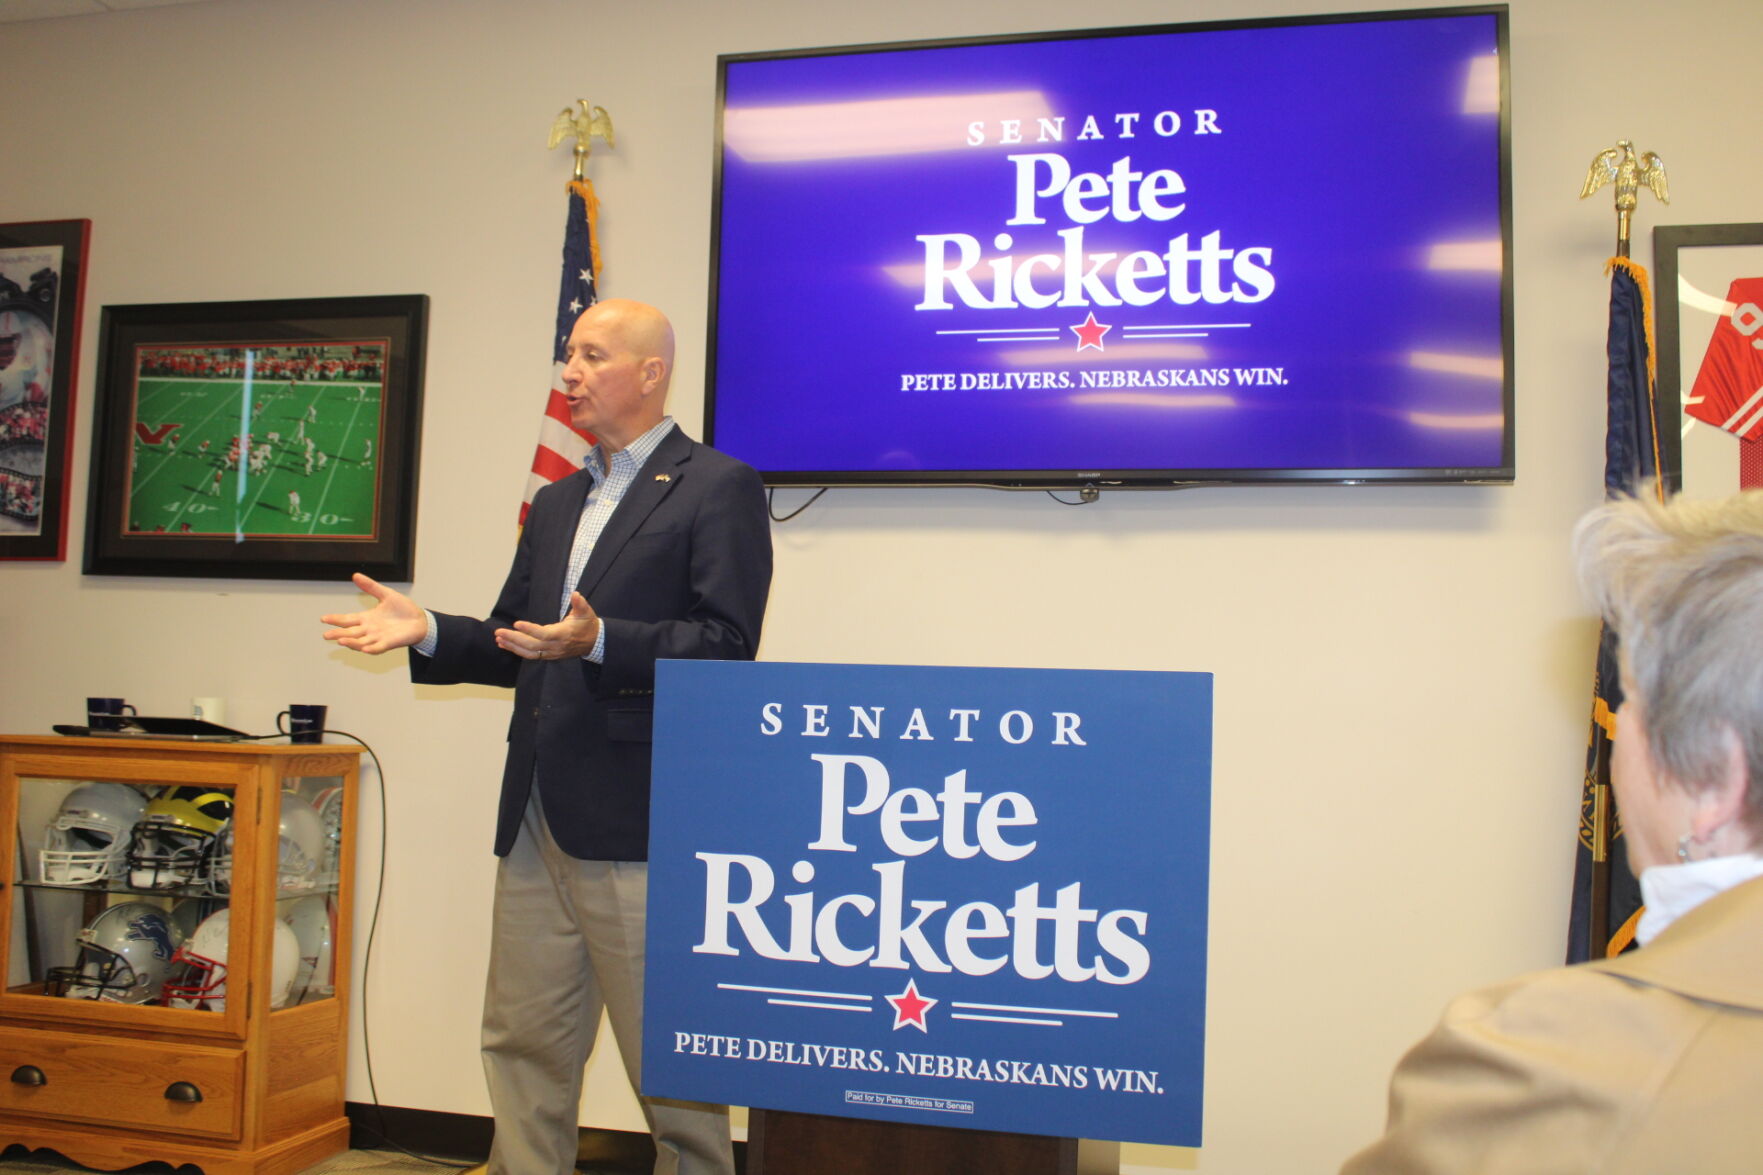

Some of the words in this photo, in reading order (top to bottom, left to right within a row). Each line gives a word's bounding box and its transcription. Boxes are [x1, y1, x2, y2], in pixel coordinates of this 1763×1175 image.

[966, 108, 1222, 146] SENATOR
[1005, 152, 1186, 226] Pete
[914, 225, 1276, 311] Ricketts
[901, 374, 957, 391] PETE
[960, 370, 1076, 390] DELIVERS.
[1080, 368, 1230, 388] NEBRASKANS
[1233, 367, 1289, 386] WIN.
[760, 702, 1088, 747] SENATOR
[807, 752, 1038, 862] Pete
[692, 851, 1151, 985] Ricketts
[674, 1031, 741, 1059] PETE
[747, 1038, 890, 1073] DELIVERS.
[896, 1052, 1089, 1090] NEBRASKANS
[1093, 1067, 1165, 1095] WIN.
[847, 1091, 863, 1101] Paid
[864, 1093, 874, 1102] for
[876, 1094, 885, 1104] by
[886, 1096, 903, 1105] Pete
[904, 1097, 933, 1108] Ricketts
[934, 1100, 944, 1109] for
[946, 1101, 972, 1111] Senate
